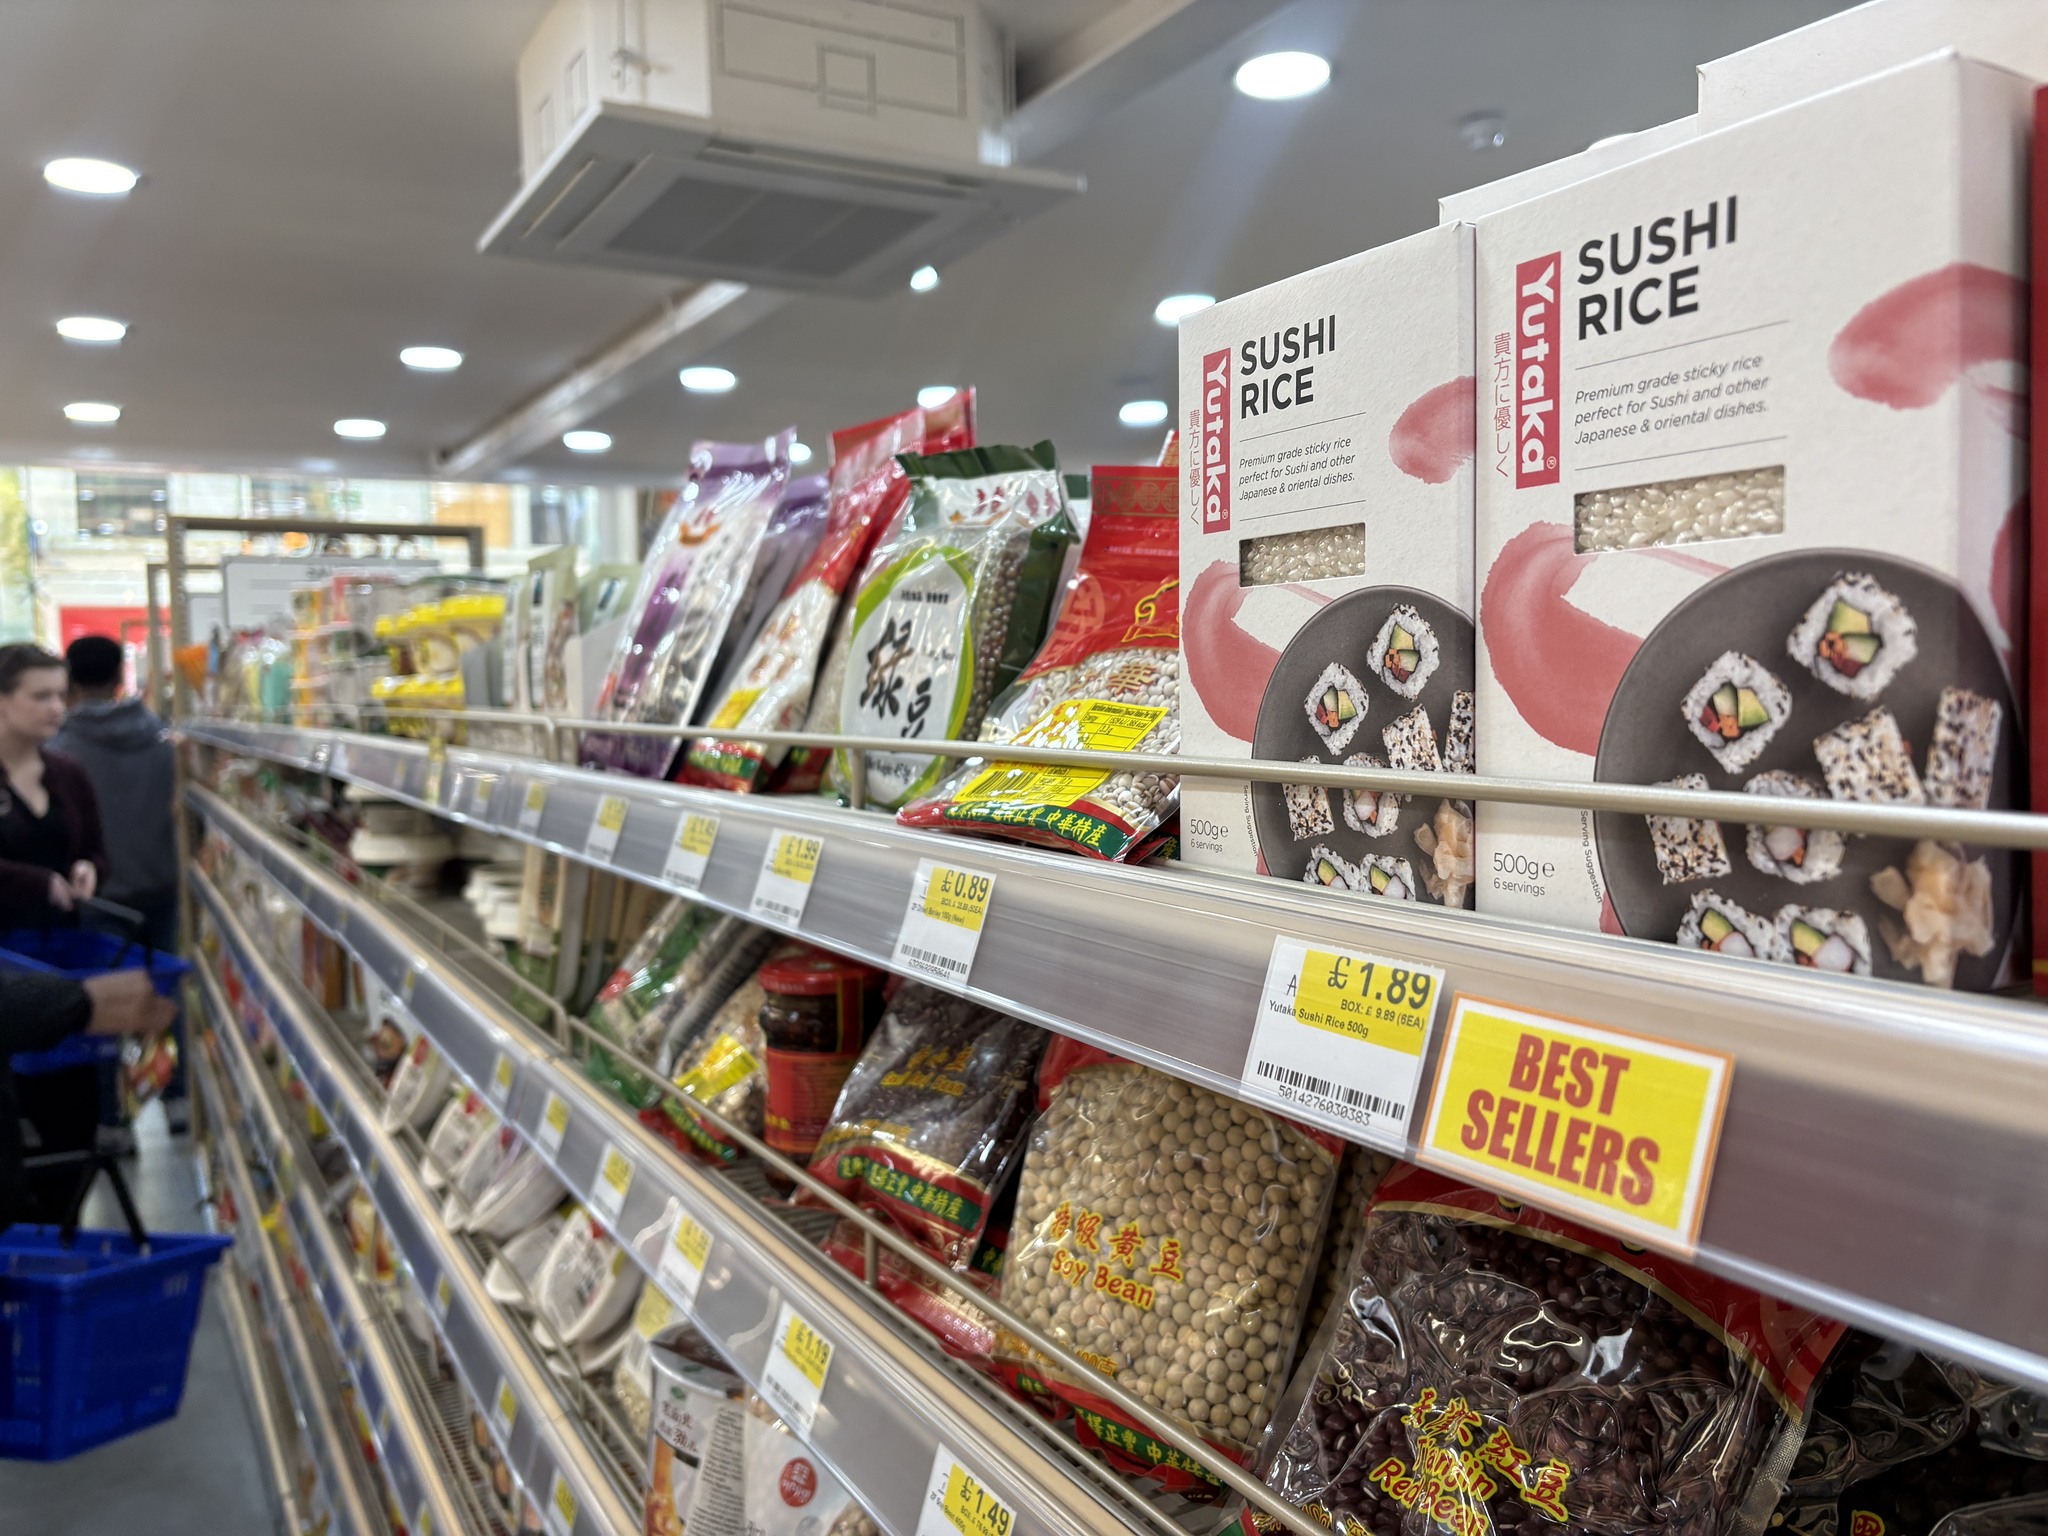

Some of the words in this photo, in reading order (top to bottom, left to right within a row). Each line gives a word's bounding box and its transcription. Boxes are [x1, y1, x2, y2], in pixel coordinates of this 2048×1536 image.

[1578, 195, 1739, 285] SUSHI
[1578, 265, 1699, 341] RICE
[1240, 315, 1336, 376] SUSHI
[1240, 366, 1314, 419] RICE
[1574, 404, 1622, 426] perfect
[1626, 400, 1646, 415] for
[1649, 390, 1689, 410] Sushi
[1692, 384, 1722, 402] and
[1725, 375, 1769, 396] other
[1575, 384, 1634, 404] Premium
[1636, 371, 1680, 394] grade
[1683, 361, 1728, 382] sticky
[1732, 354, 1763, 373] rice
[1493, 332, 1511, 477] 貴方に優しく
[1574, 424, 1636, 445] Japanese
[1640, 418, 1650, 432] &
[1654, 408, 1709, 431] oriental
[1713, 400, 1767, 420] dishes.
[1188, 409, 1201, 525] 貴方に優しく
[1239, 453, 1275, 469] Premium
[1277, 446, 1302, 463] grade
[1304, 440, 1331, 456] sticky
[1333, 437, 1351, 450] rice
[1239, 471, 1268, 487] perfect
[1270, 468, 1283, 479] for
[1285, 461, 1308, 476] Sushi
[1310, 457, 1328, 471] and
[1330, 454, 1356, 468] other
[1239, 486, 1277, 501] Japanese
[1279, 482, 1285, 494] &
[1287, 476, 1321, 492] oriental
[1323, 472, 1355, 486] dishes.
[1190, 838, 1195, 848] 6
[1196, 841, 1223, 853] servings
[1245, 815, 1258, 857] Suggestion
[1580, 810, 1589, 847] Serving
[1493, 877, 1500, 889] 6
[1502, 880, 1545, 897] servings
[1584, 849, 1603, 904] Suggestion
[1286, 974, 1298, 997] A
[1269, 1000, 1297, 1017] Yutaka
[1298, 1008, 1324, 1025] Sushi
[1325, 1015, 1345, 1030] Rice
[1347, 1021, 1369, 1039] 500g
[1340, 999, 1364, 1016] BOX:
[1375, 1007, 1396, 1023] 9.89
[1397, 1011, 1425, 1031] (6EA)
[1509, 1033, 1631, 1117] BEST
[1278, 1084, 1371, 1126] 5014276030383
[1460, 1089, 1661, 1207] SELLERS
[1051, 1248, 1088, 1286] Soy
[1094, 1264, 1154, 1310] Bean
[1369, 1457, 1426, 1509] Red
